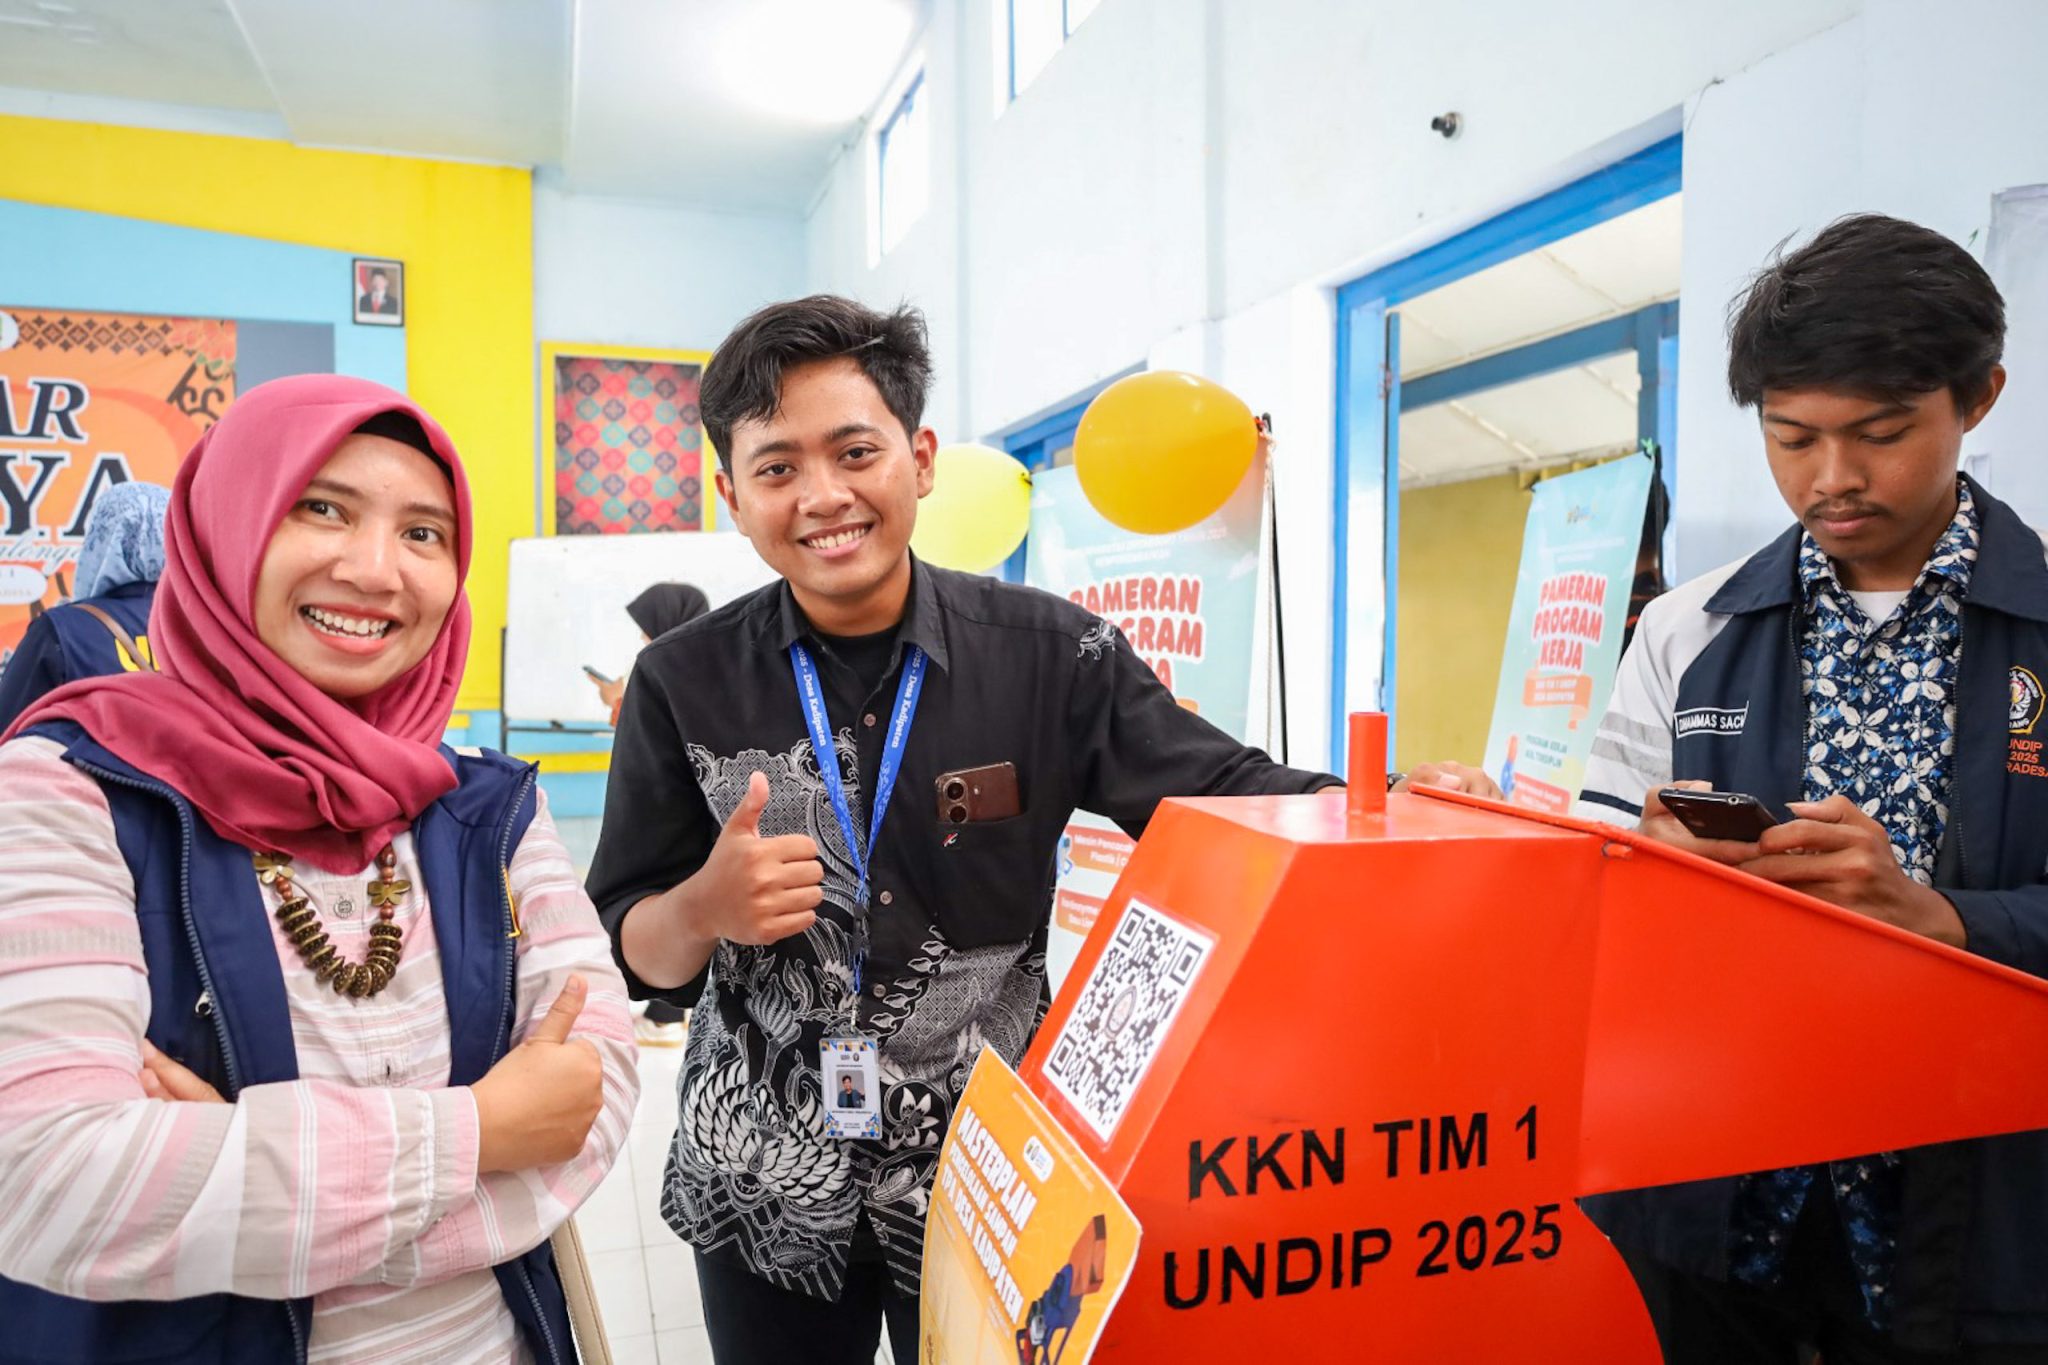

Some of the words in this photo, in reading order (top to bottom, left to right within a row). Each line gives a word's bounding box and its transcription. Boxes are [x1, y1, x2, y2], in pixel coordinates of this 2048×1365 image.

[1533, 607, 1603, 642] PROGRAM
[1541, 575, 1606, 607] PAMERAN
[1540, 638, 1584, 670] KERJA
[957, 1105, 1038, 1232] MASTERPLAN
[1188, 1127, 1345, 1201] KKN
[1373, 1112, 1488, 1179] TIM
[1515, 1104, 1537, 1161] 1
[954, 1187, 976, 1238] DESA
[972, 1220, 1024, 1325] KADIPATEN
[1163, 1227, 1392, 1311] UNDIP
[1416, 1203, 1562, 1277] 2025
